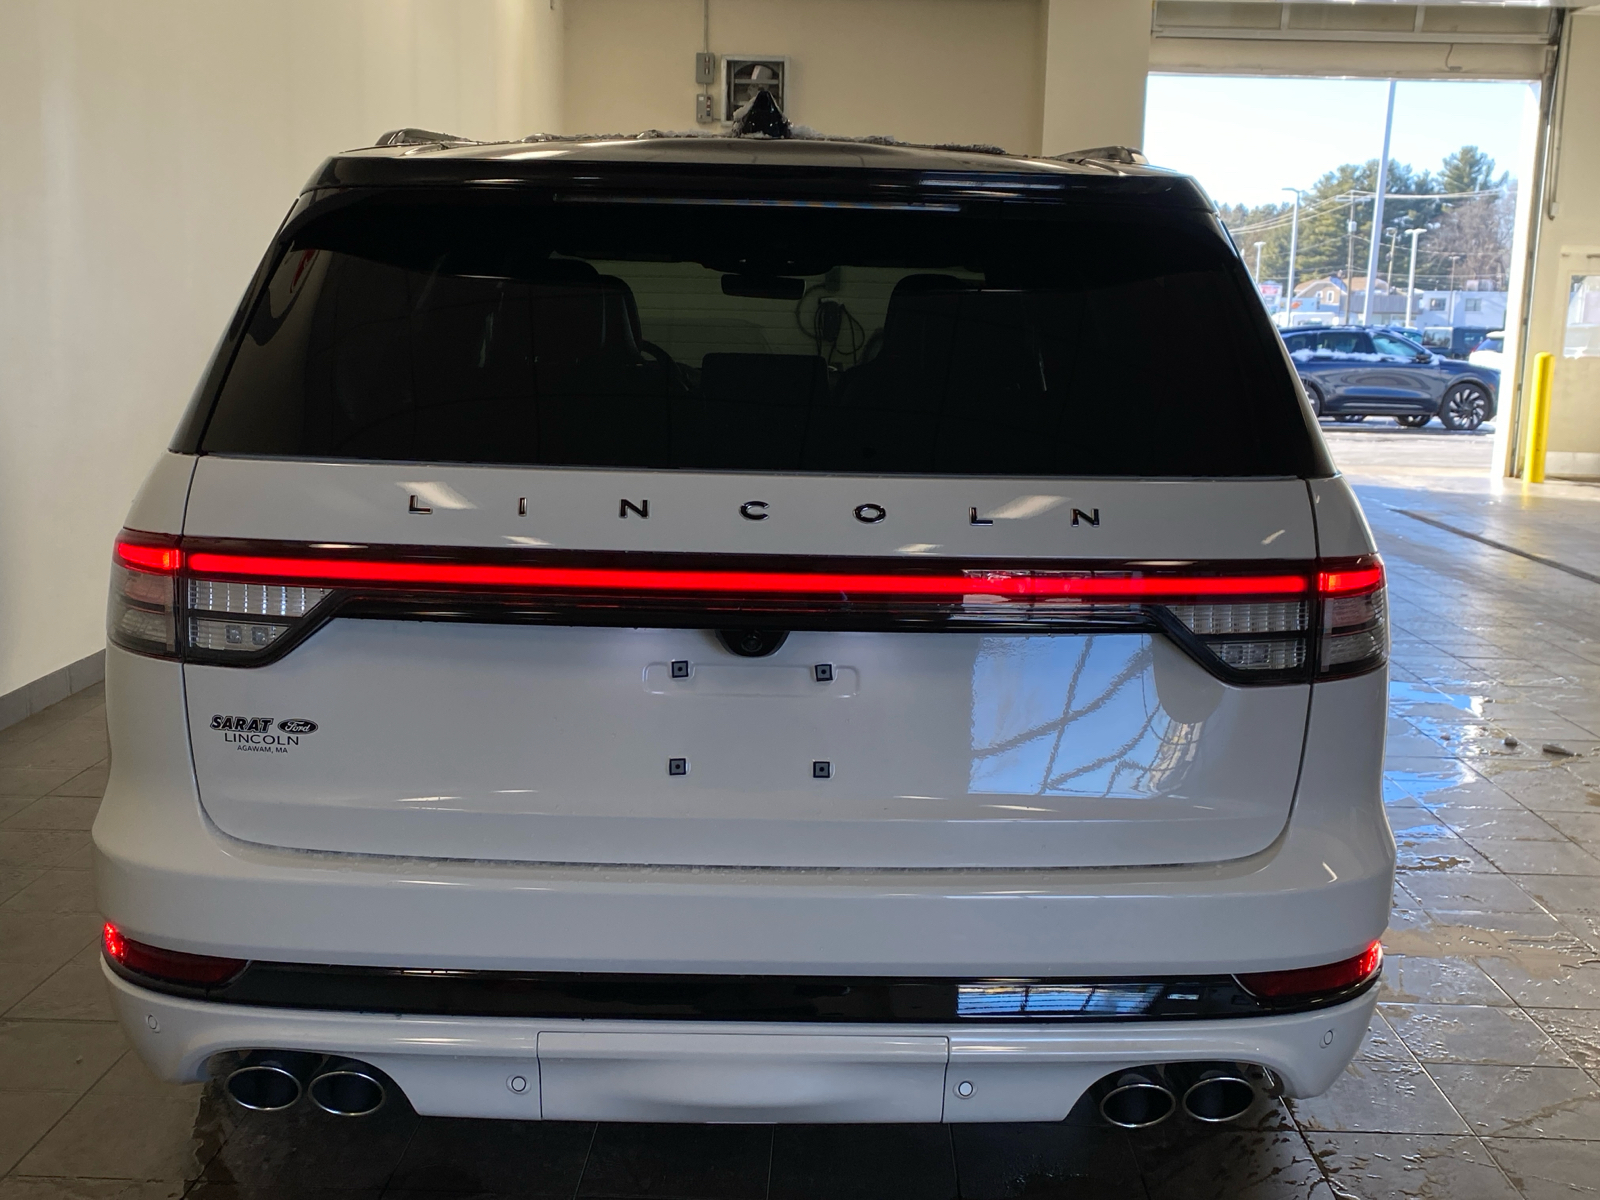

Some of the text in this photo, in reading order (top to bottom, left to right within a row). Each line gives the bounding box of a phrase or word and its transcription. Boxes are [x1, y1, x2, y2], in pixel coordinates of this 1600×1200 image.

[408, 494, 1101, 527] LINCOLN
[210, 714, 313, 734] SARAT Ford
[224, 732, 299, 746] LINCOLN
[237, 744, 288, 754] AGAWAM, MA
